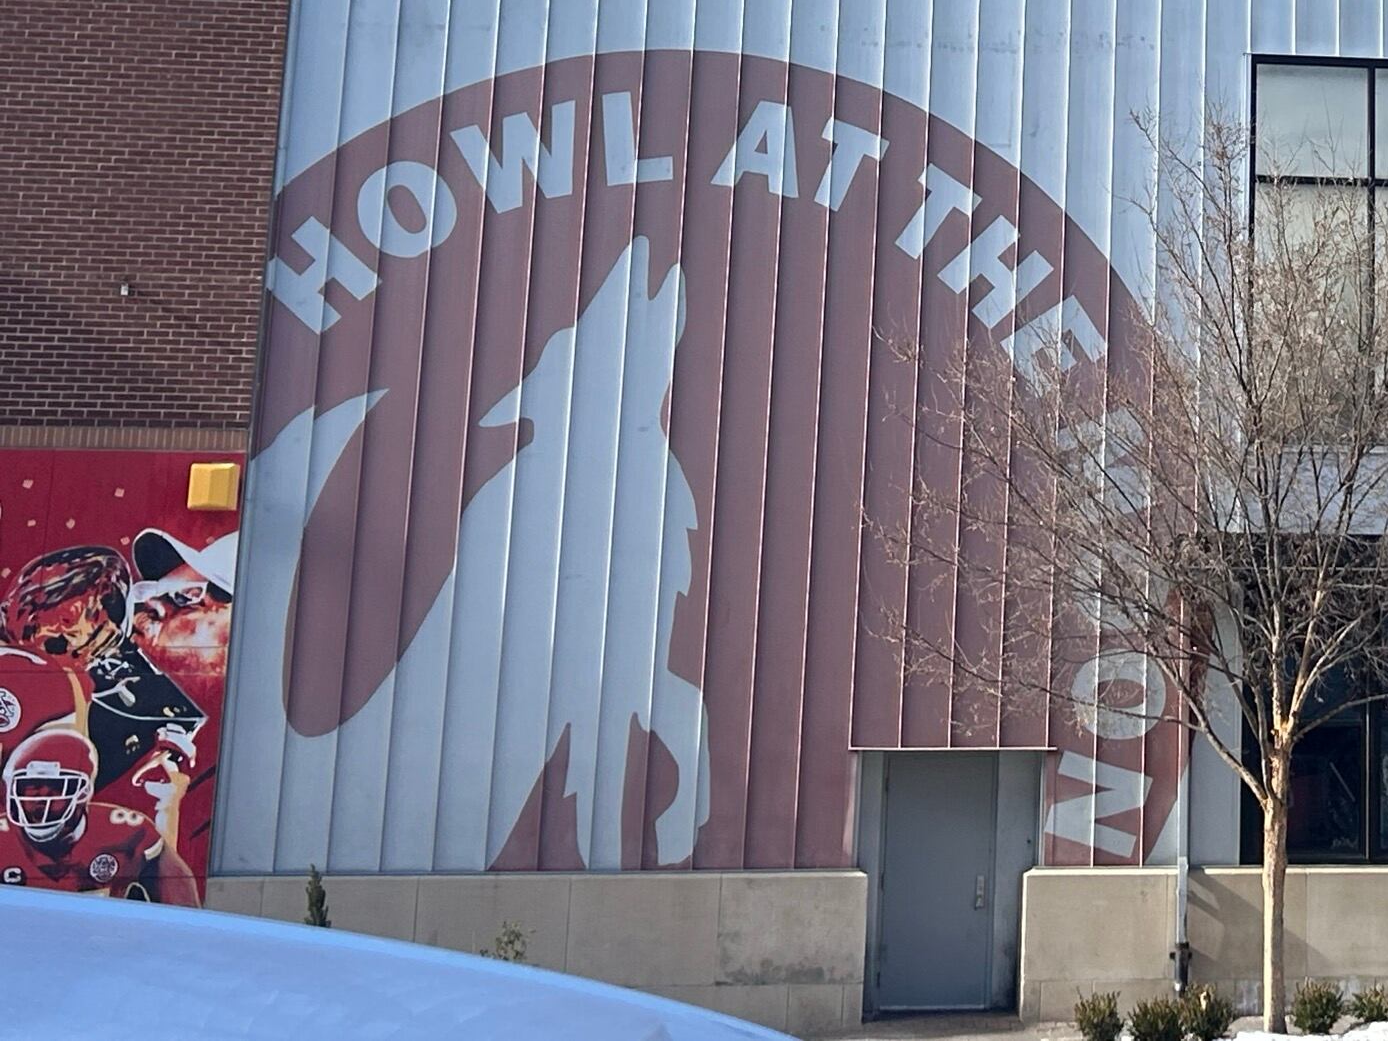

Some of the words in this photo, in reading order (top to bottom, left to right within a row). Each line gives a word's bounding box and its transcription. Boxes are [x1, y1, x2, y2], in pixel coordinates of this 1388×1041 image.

[267, 92, 674, 335] HOWL
[711, 100, 888, 212] AT
[894, 170, 1110, 399] THE
